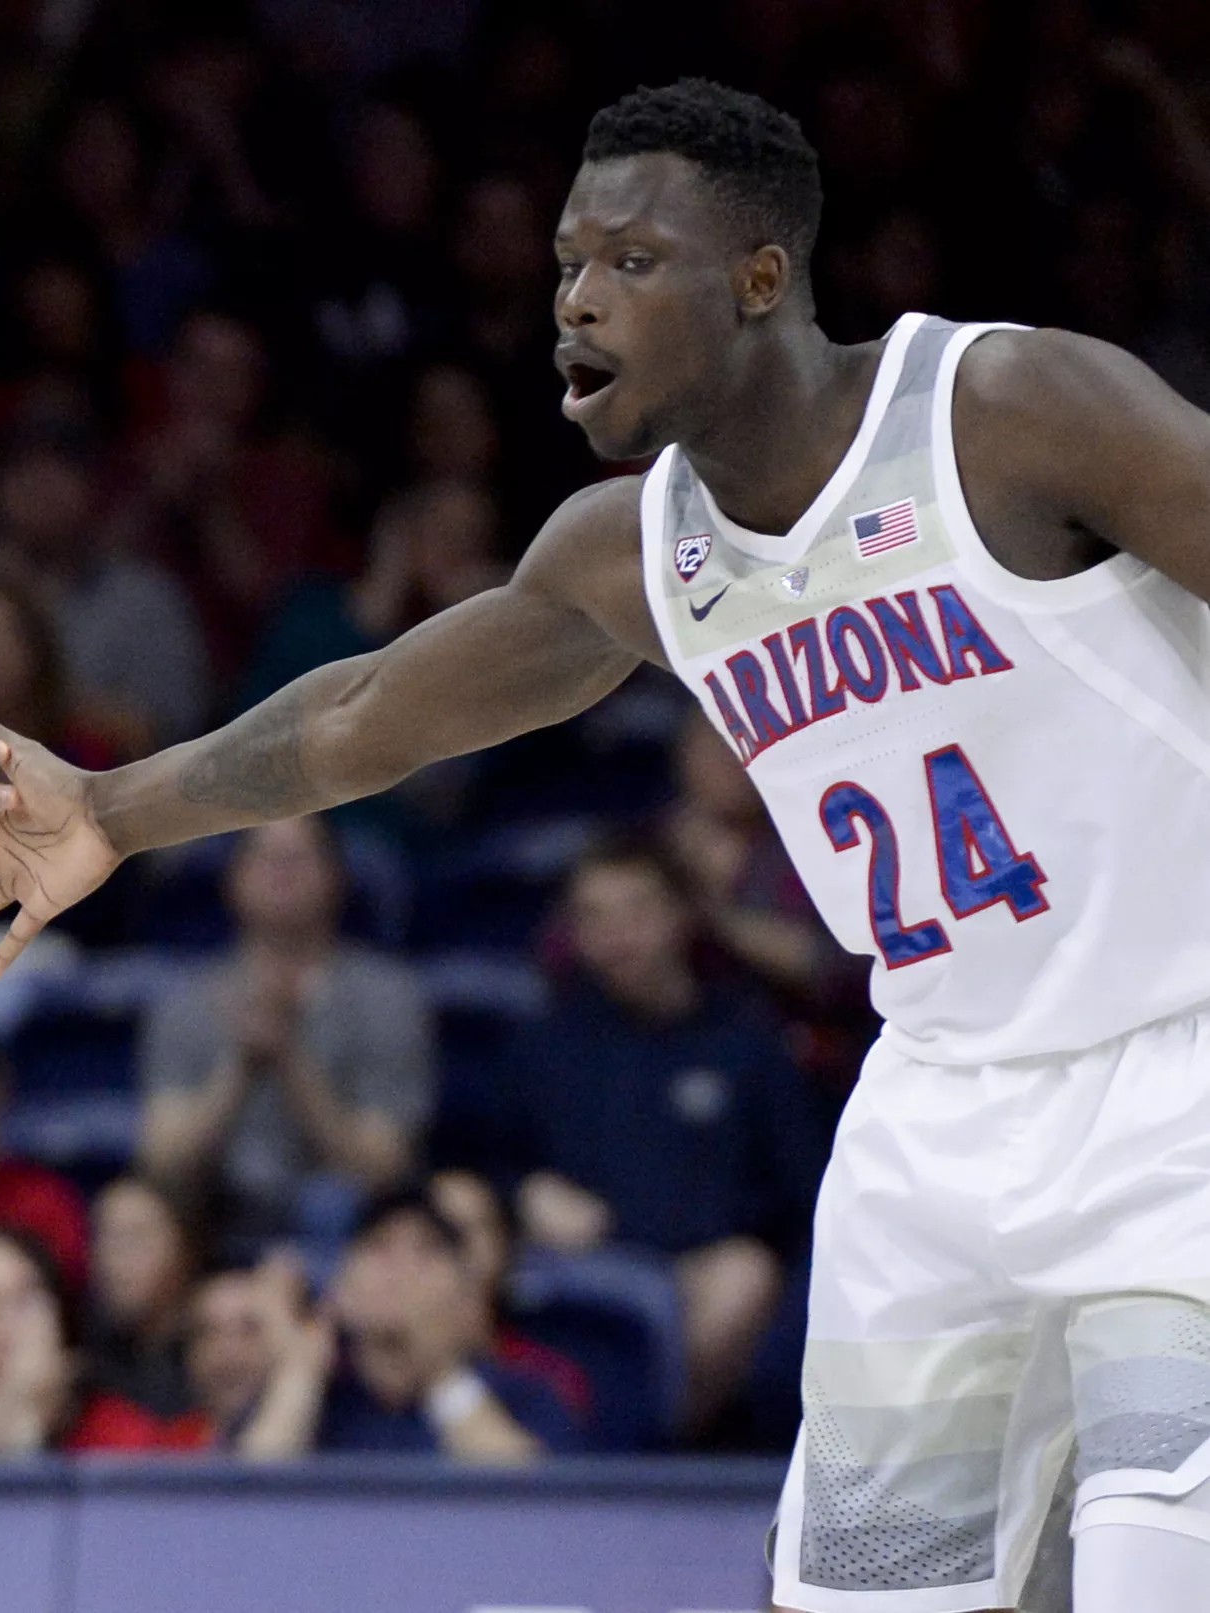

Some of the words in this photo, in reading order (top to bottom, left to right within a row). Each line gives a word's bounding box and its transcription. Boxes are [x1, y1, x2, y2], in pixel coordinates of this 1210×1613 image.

[676, 535, 711, 564] PAC
[679, 554, 699, 572] 12
[703, 583, 1015, 768] ARIZONA
[818, 743, 1052, 972] 24
